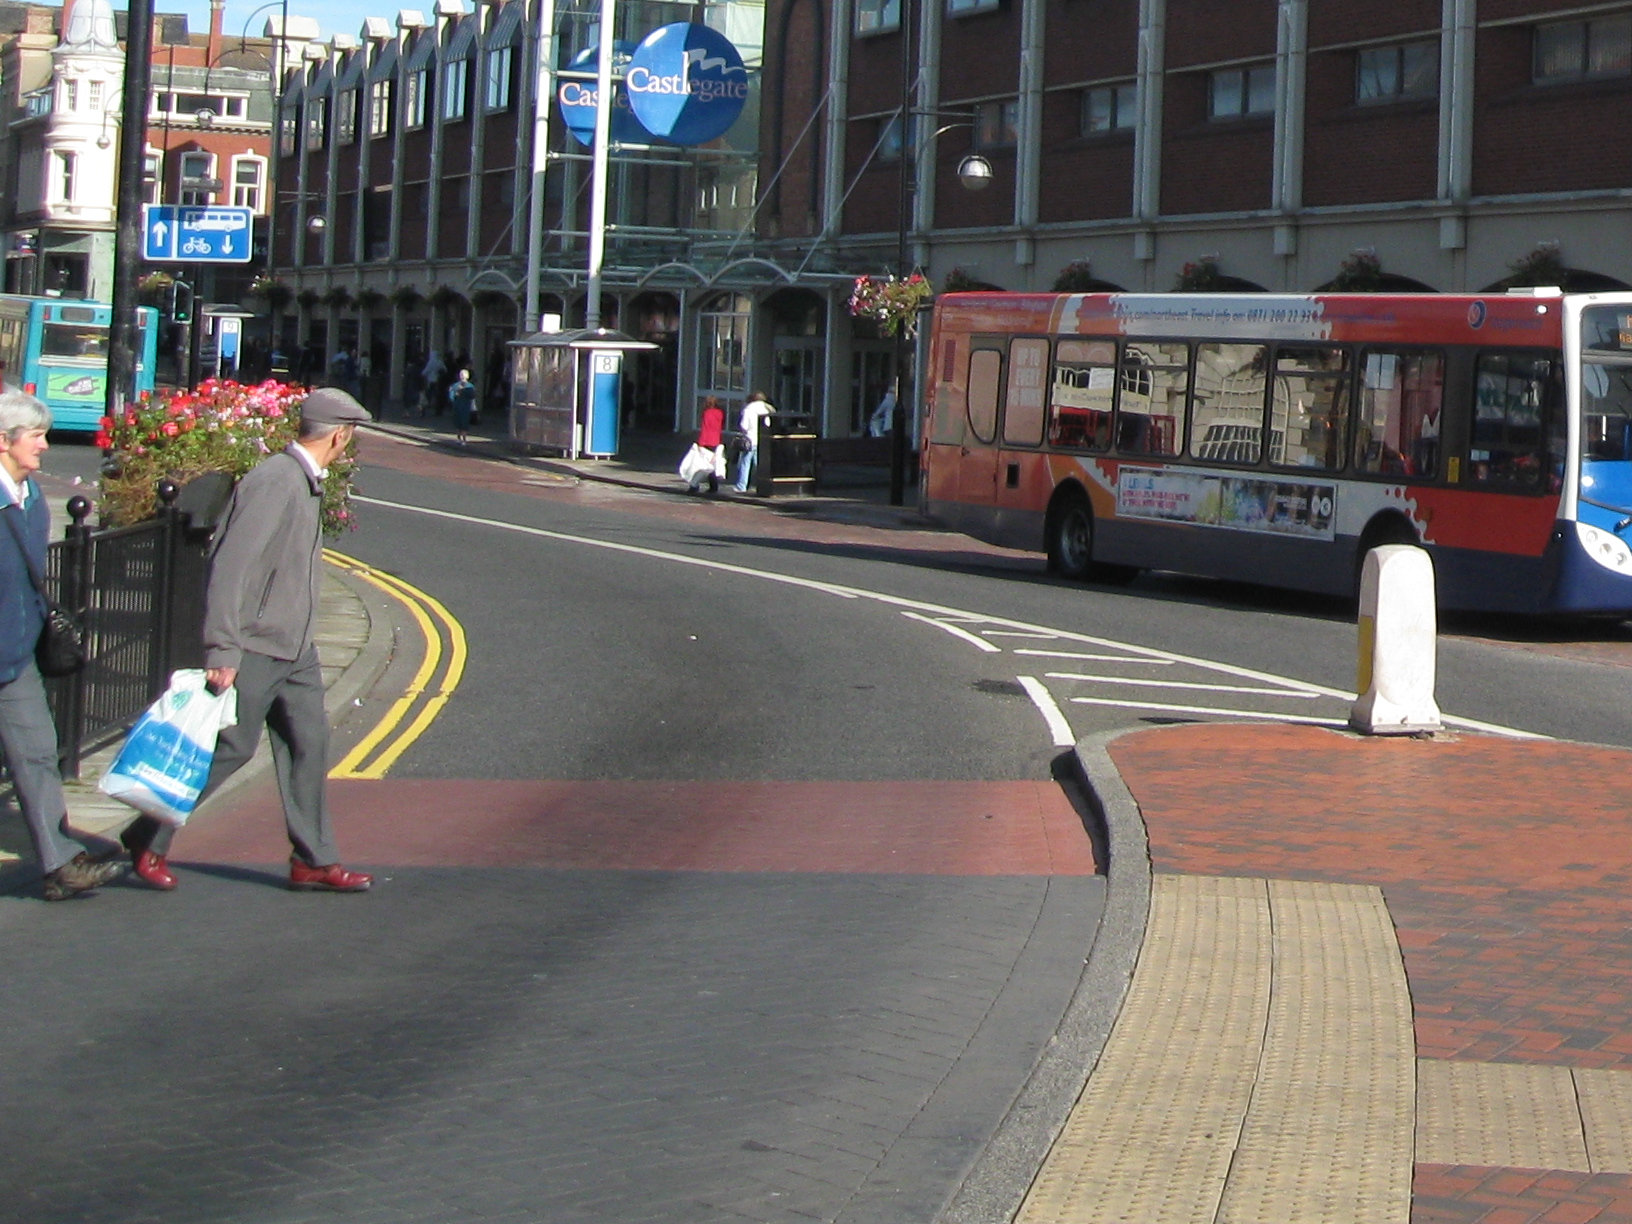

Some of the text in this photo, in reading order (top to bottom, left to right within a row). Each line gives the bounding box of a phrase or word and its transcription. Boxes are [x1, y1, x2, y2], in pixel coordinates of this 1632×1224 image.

[627, 51, 747, 101] Castlegate
[227, 322, 234, 332] 9
[603, 357, 612, 371] 8
